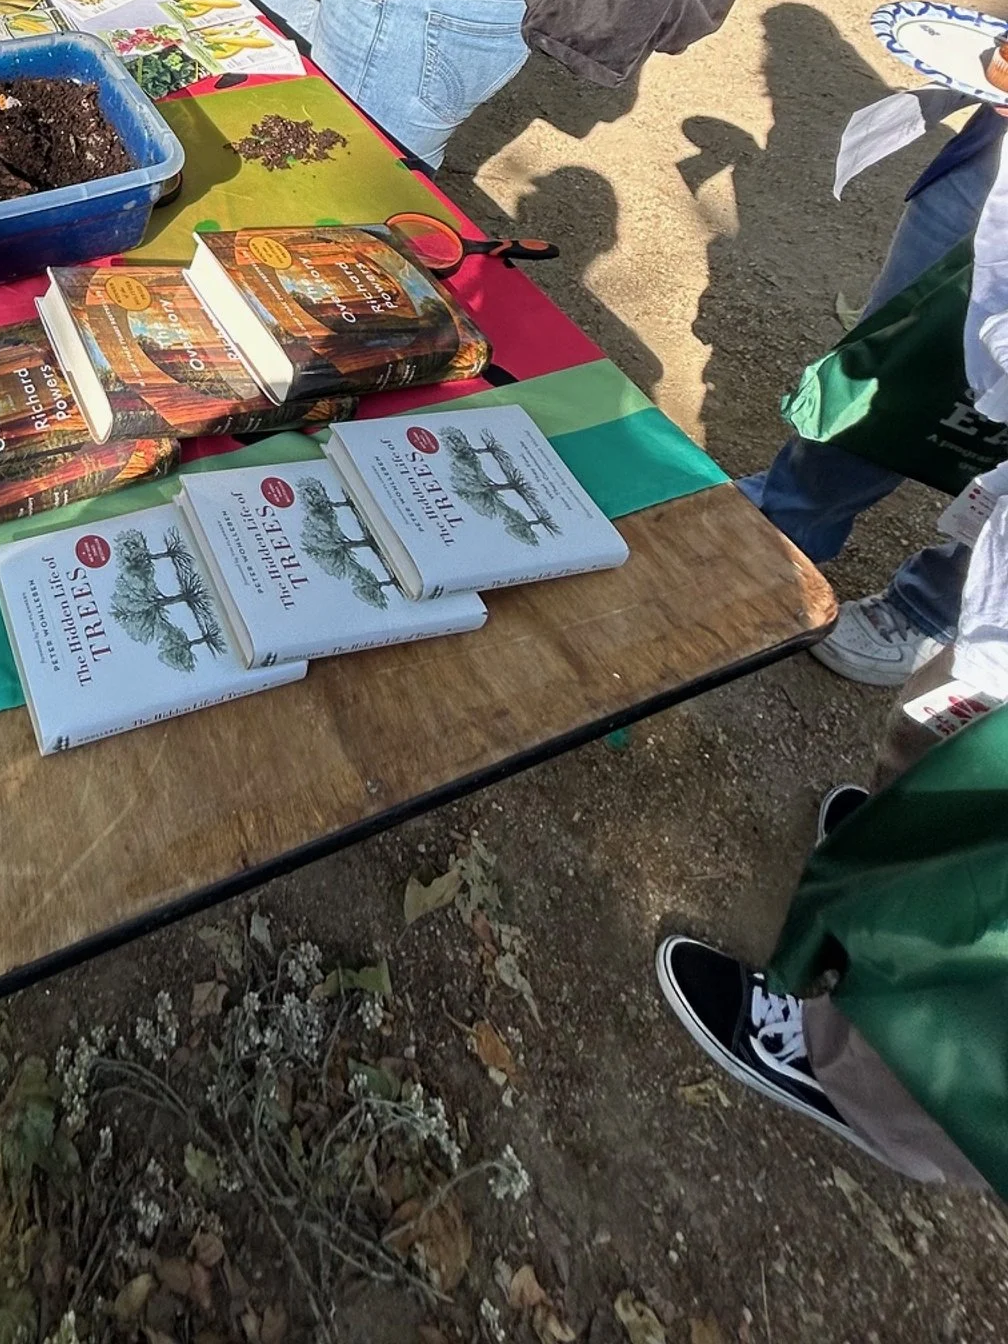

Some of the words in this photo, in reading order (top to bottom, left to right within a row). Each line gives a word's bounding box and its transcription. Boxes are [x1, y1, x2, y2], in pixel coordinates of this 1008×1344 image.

[299, 257, 357, 324] Overstory
[301, 278, 322, 304] The
[336, 262, 385, 313] Richard
[355, 262, 399, 310] Powers
[159, 299, 205, 371] Overstory
[13, 368, 51, 431] Richard
[41, 364, 72, 422] Powers
[380, 438, 395, 450] of
[392, 451, 410, 475] Life
[231, 491, 246, 504] of
[374, 456, 406, 504] WOHLLEBEN
[405, 452, 464, 528] TREES
[407, 477, 438, 519] Hidden
[222, 510, 249, 563] WOHLLEBEN
[240, 506, 258, 530] Life
[405, 507, 424, 532] PETER
[436, 521, 455, 547] The
[42, 556, 57, 569] of
[254, 533, 282, 579] Hidden
[255, 505, 309, 590] TREES
[48, 575, 66, 599] Life
[246, 566, 264, 594] PETER
[278, 582, 295, 610] The
[28, 579, 49, 637] WOHLLEBEN
[61, 601, 83, 654] Hidden
[66, 566, 112, 662] TREES
[46, 640, 60, 672] PETER
[77, 655, 93, 687] The
[154, 706, 192, 721] Hidden
[193, 697, 211, 710] Life
